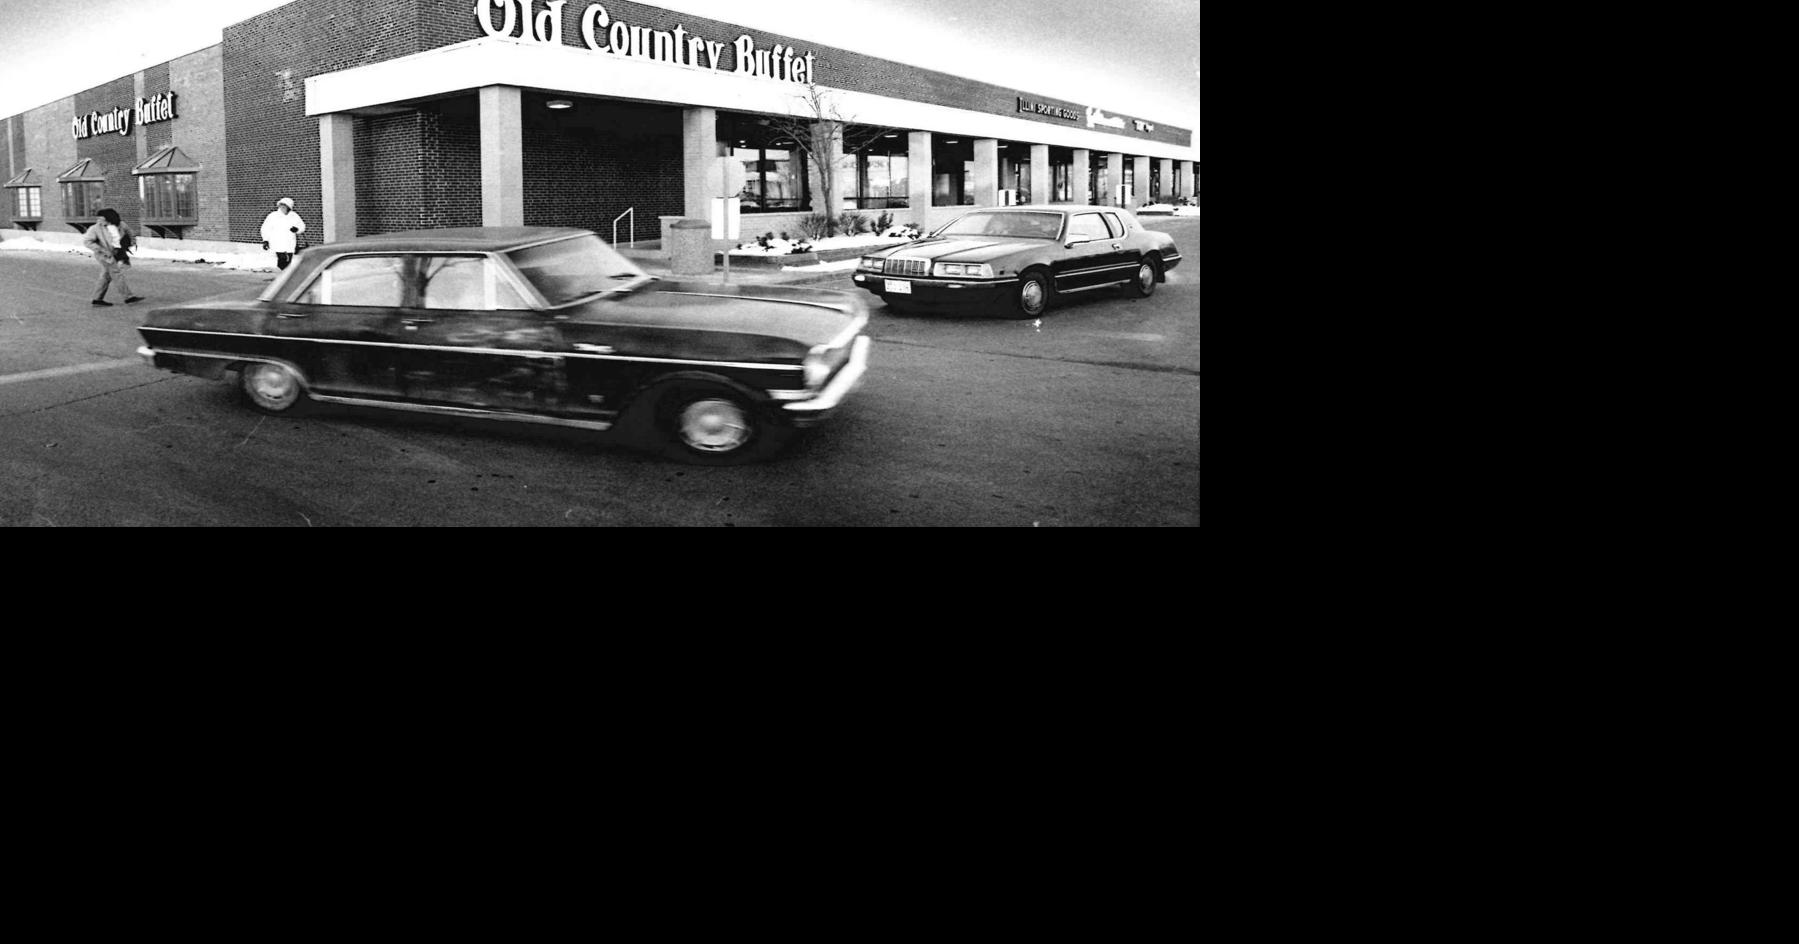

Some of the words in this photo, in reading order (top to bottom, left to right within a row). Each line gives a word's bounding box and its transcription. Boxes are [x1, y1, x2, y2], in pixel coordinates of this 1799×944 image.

[474, 0, 566, 46] Old
[581, 3, 725, 74] Country
[733, 34, 816, 85] Buffet
[72, 115, 89, 140] Old
[91, 106, 131, 136] Country
[134, 91, 175, 126] Buffet
[1037, 103, 1062, 117] SPORTING
[1062, 108, 1080, 121] GOODS
